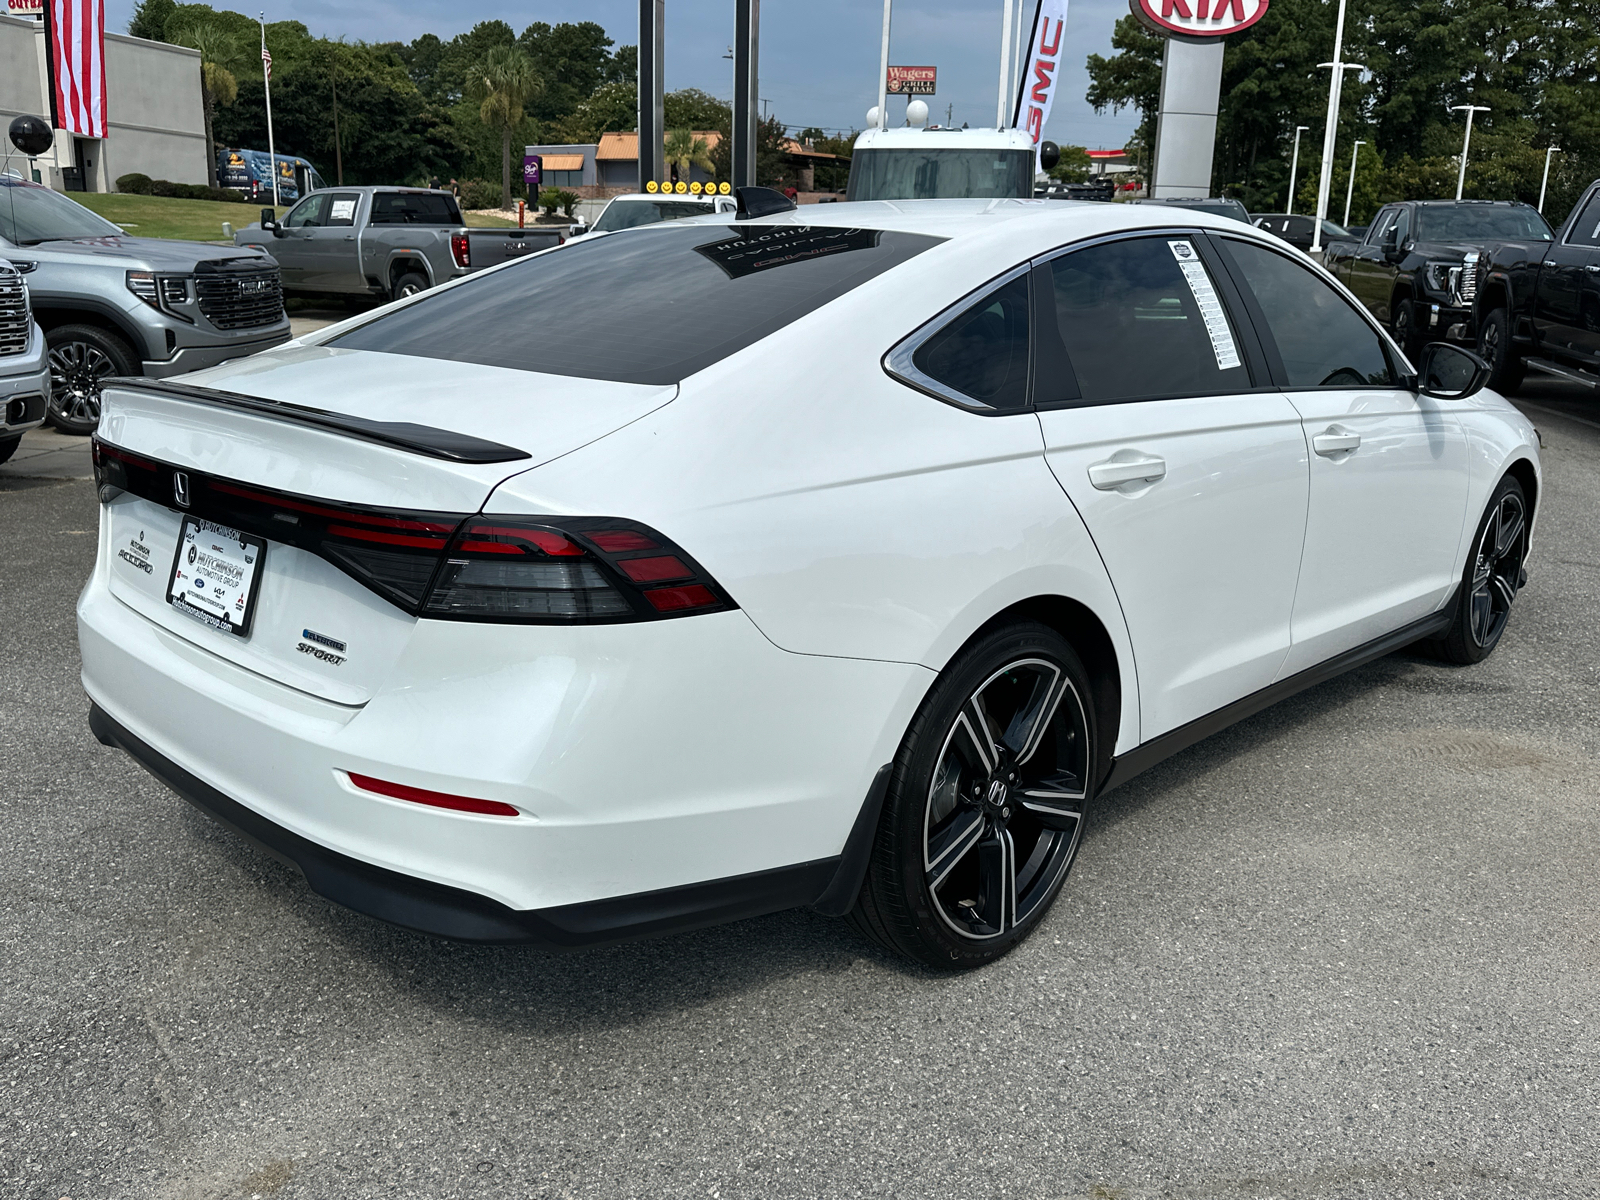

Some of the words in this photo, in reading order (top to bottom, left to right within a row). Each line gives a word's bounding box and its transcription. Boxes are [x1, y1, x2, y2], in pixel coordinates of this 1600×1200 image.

[889, 67, 934, 80] Wagers
[1026, 16, 1063, 144] GMC
[205, 521, 241, 541] HUTCHINSON
[211, 544, 224, 553] GMC
[197, 551, 244, 580] HUTCHINSON
[195, 566, 223, 583] AUTOMOTIVE
[223, 576, 239, 588] GROUP
[296, 642, 347, 666] SPORT
